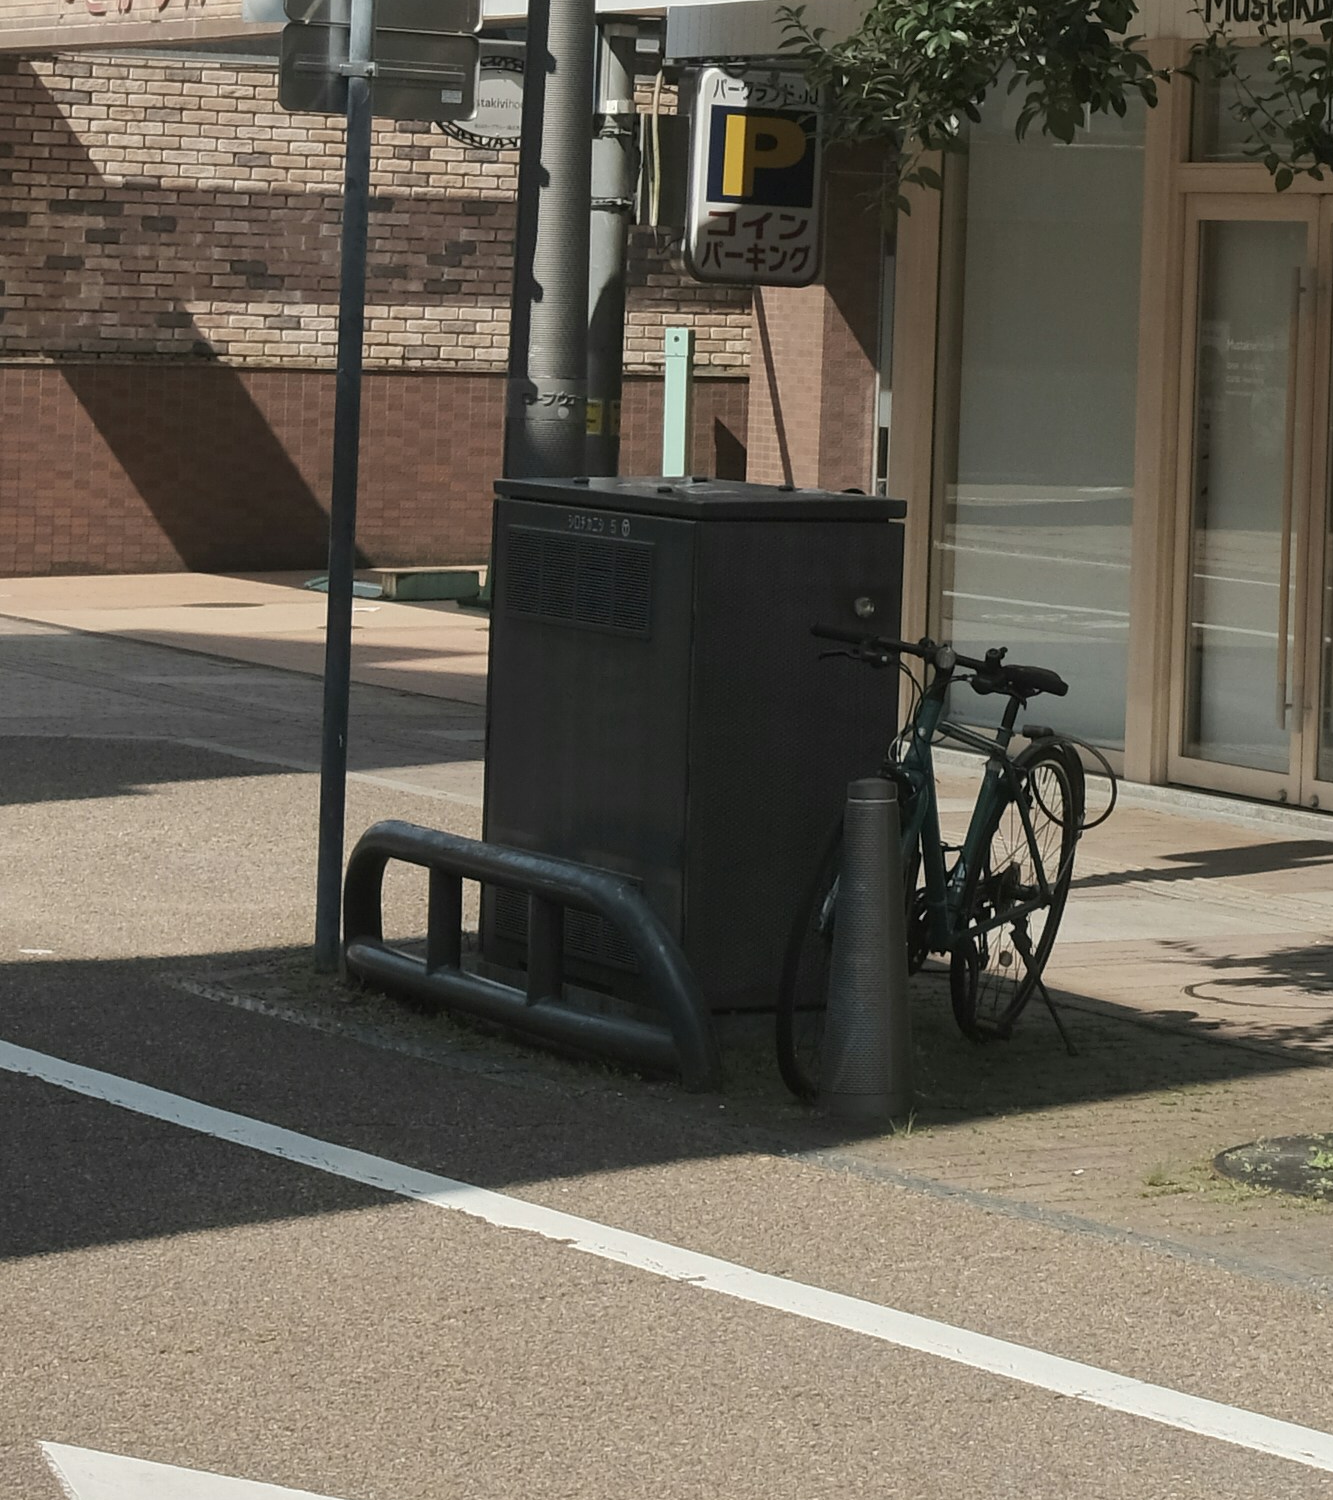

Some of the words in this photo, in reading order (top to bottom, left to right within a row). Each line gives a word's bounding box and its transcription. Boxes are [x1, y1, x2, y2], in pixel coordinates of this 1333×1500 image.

[721, 114, 806, 197] P
[706, 210, 809, 240] コイン
[701, 240, 812, 274] パーキング
